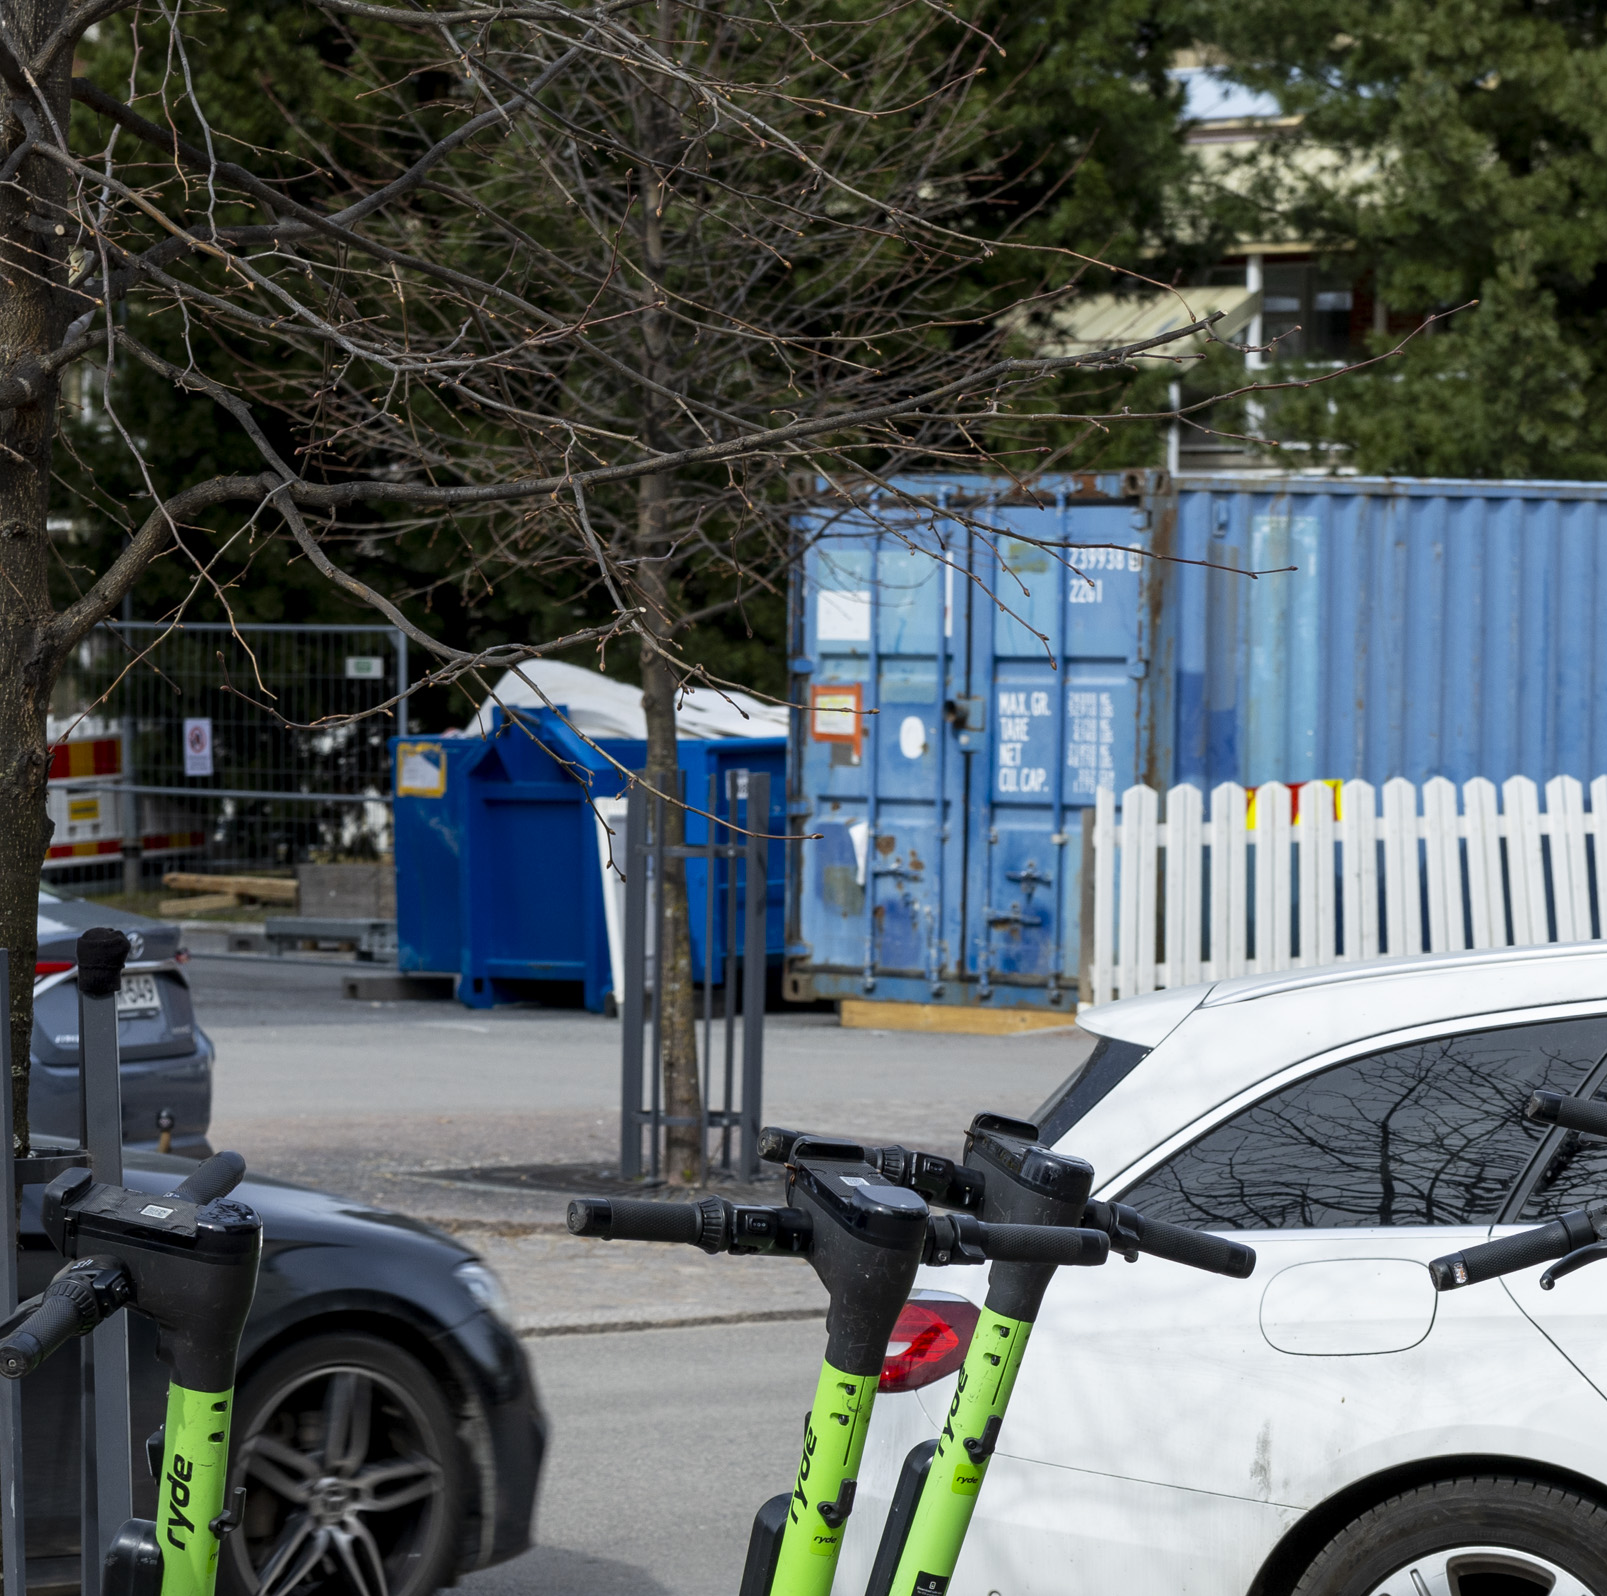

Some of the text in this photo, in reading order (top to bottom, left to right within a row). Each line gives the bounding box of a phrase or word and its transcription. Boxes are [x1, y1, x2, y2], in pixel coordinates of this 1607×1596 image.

[998, 742, 1023, 767] NET
[792, 1426, 818, 1525] ryde
[956, 1476, 979, 1485] ryde
[166, 1453, 195, 1551] ryde
[813, 1535, 838, 1545] ryde
